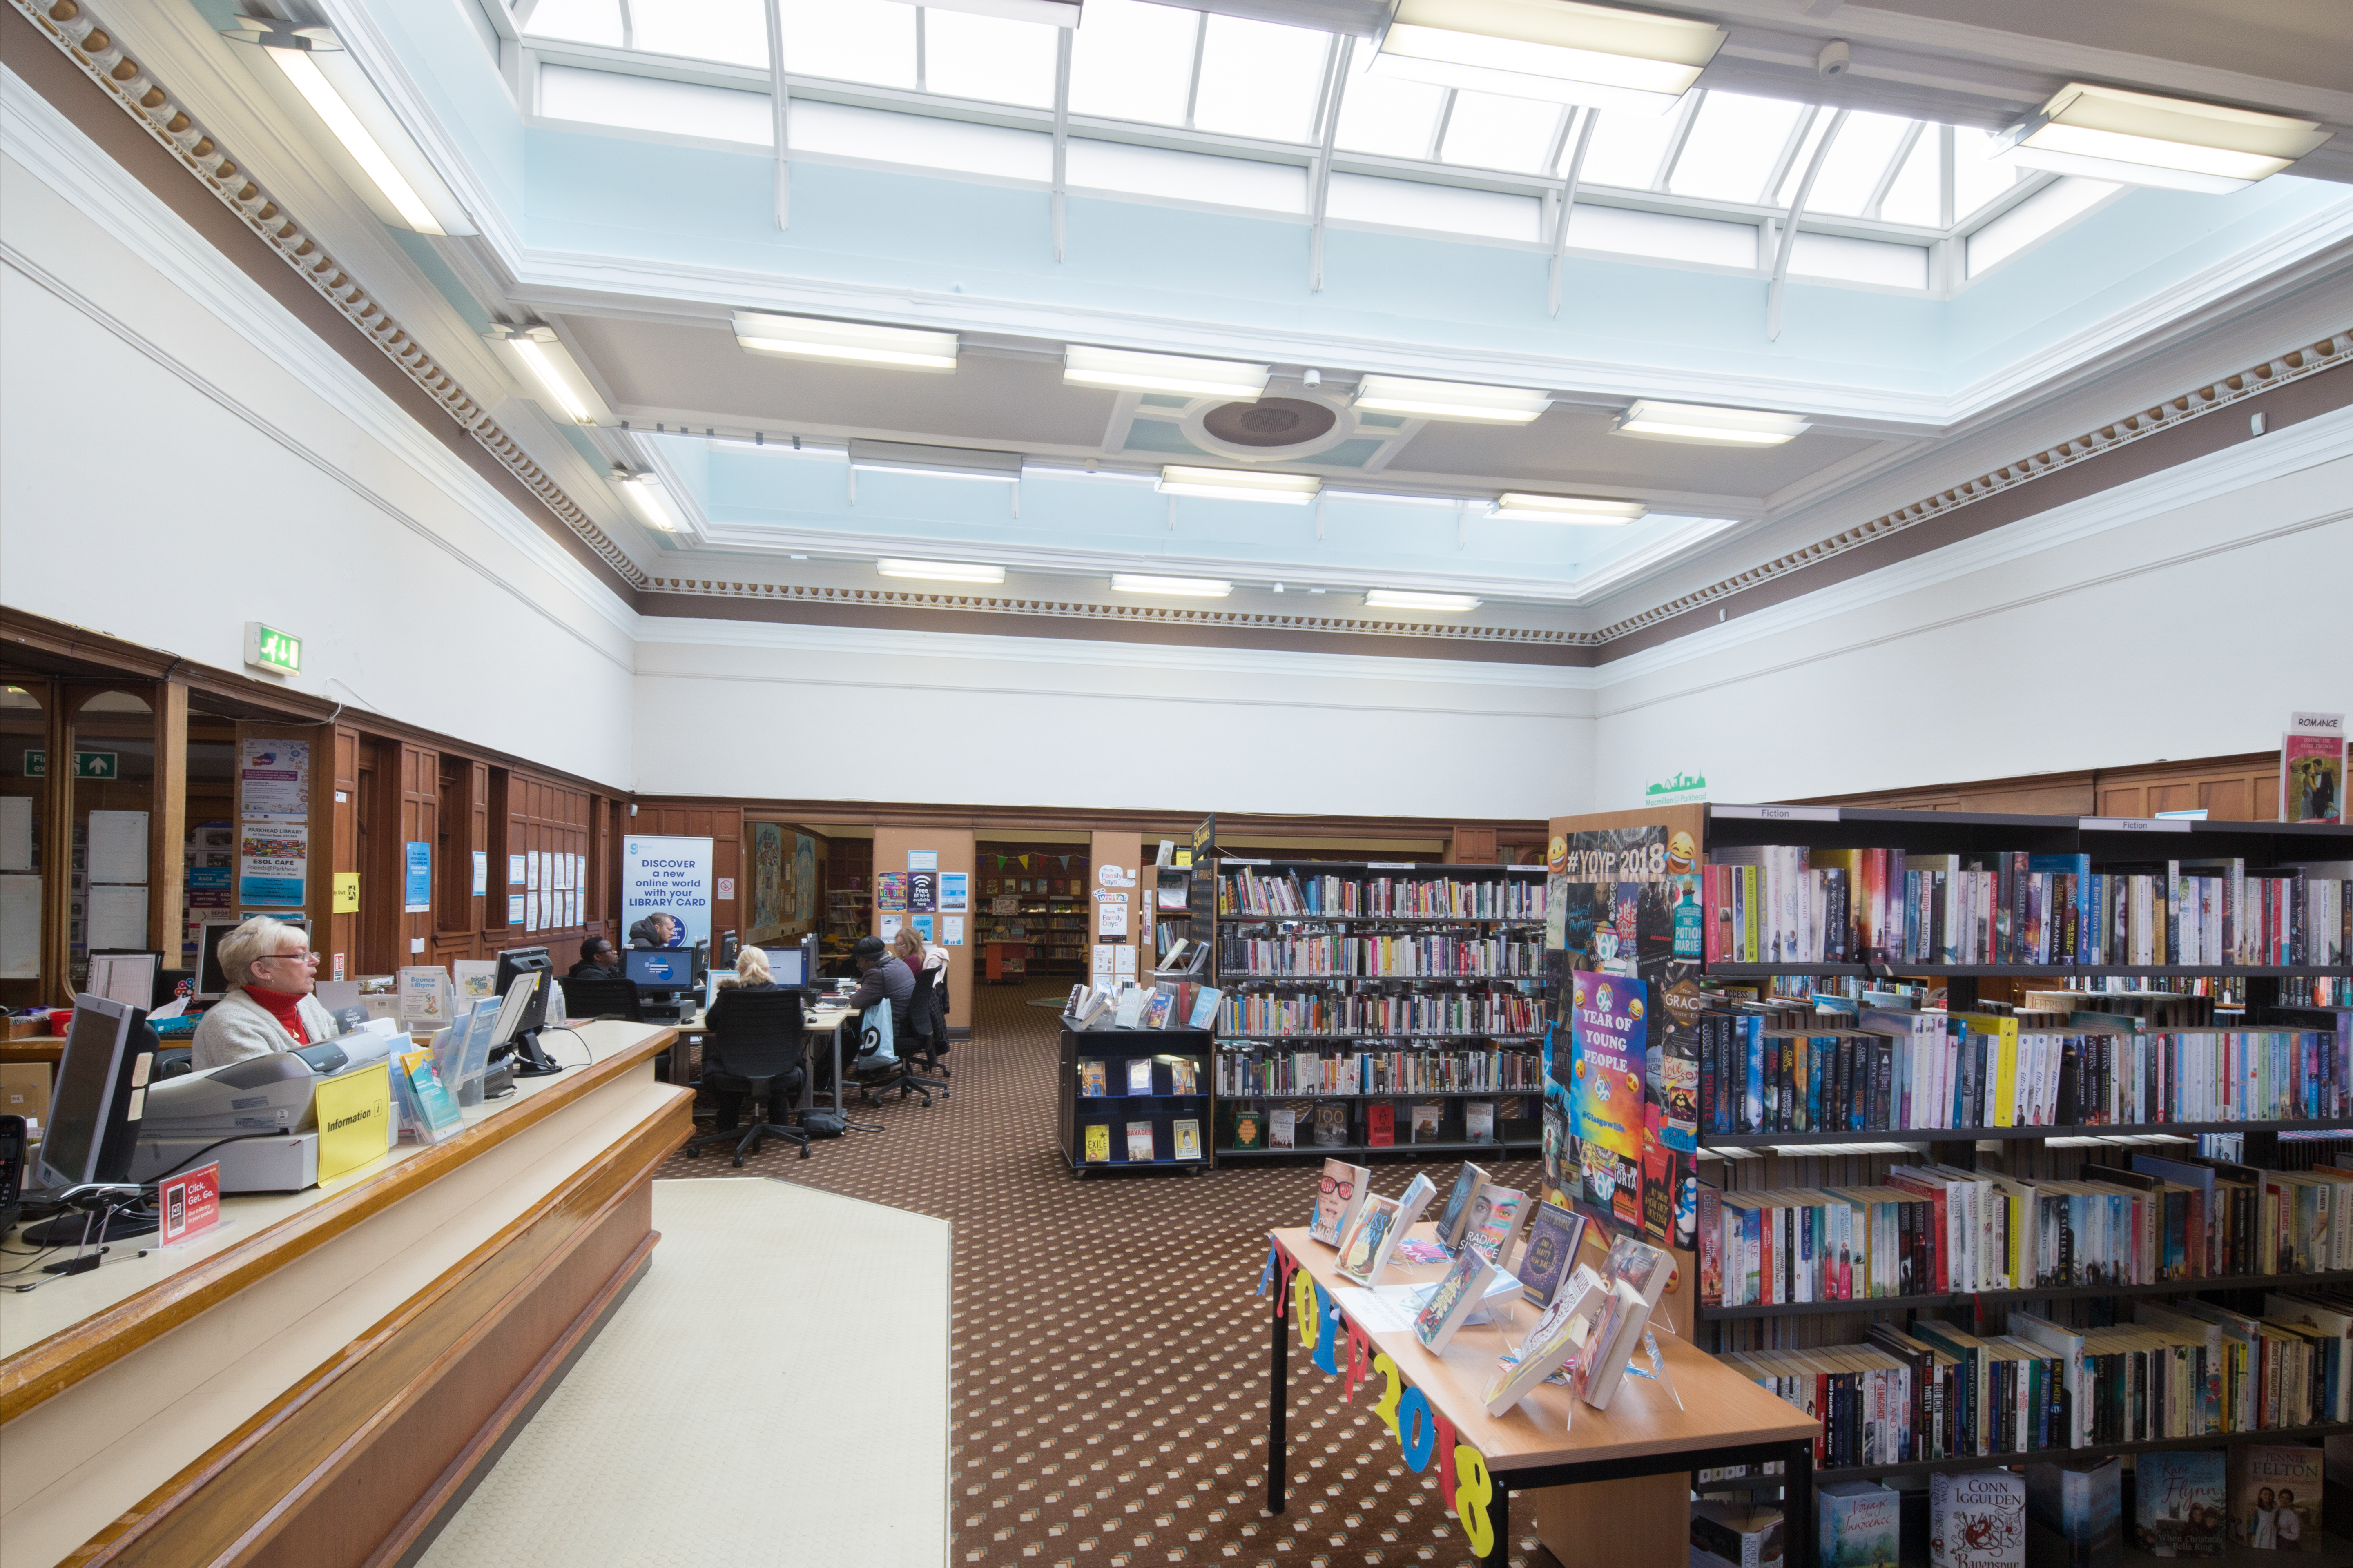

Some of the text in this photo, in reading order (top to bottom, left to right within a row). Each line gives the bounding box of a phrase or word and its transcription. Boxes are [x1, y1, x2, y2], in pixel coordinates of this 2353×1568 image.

[2298, 718, 2338, 728] ROMANCE
[1761, 808, 1789, 818] Fiction
[2123, 821, 2148, 829] Fiction
[1197, 827, 1210, 847] BOOKS
[642, 859, 696, 868] DISCOVER
[1567, 842, 1665, 873] #YOYP 2018
[1198, 869, 1212, 880] ARRIVALS
[644, 889, 692, 898] with your
[1093, 888, 1105, 897] wee
[1683, 917, 1693, 926] THE
[1724, 989, 1748, 998] ACCESS
[1582, 1009, 1633, 1032] YEAR OF
[1585, 1029, 1628, 1052] YOUNG
[1584, 1049, 1628, 1073] PEOPLE
[1704, 1074, 1714, 1120] PIRATE
[327, 1108, 371, 1133] Information
[1316, 1109, 1344, 1123] 100
[1582, 1111, 1626, 1133] @Glasgowlife
[1088, 1139, 1107, 1149] EXILE
[188, 1182, 205, 1194] Click.
[1320, 1176, 1354, 1199] GEEK GIRL
[188, 1190, 214, 1205] Get. Go.
[192, 1215, 201, 1223] your
[201, 1208, 214, 1218] pocket!
[195, 1204, 211, 1213] e-library
[1614, 1209, 1637, 1225] HELEN DENNIS
[1704, 1194, 1713, 1235] DEMILLE
[1318, 1214, 1338, 1229] HOLLY
[1362, 1209, 1388, 1232] KISS
[1539, 1209, 1572, 1231] HOLLY BOURNE
[1310, 1222, 1339, 1243] SMALE
[1356, 1226, 1381, 1248] CAM
[1466, 1231, 1499, 1247] RADIO
[1536, 1248, 1551, 1259] HAPPY
[1924, 1367, 1933, 1385] RED
[1877, 1384, 1885, 1420] SLINGSHOT
[1924, 1385, 1932, 1412] MOTH
[1934, 1383, 1943, 1413] RED ICON
[2266, 1452, 2306, 1464] JENNIE
[2162, 1459, 2190, 1476] Katie
[2252, 1461, 2319, 1478] FELTON
[1968, 1479, 2009, 1493] CONN
[2161, 1476, 2219, 1512] Flynn
[1954, 1487, 2022, 1509] IGGULDEN
[1851, 1498, 1888, 1516] Voyage
[1842, 1516, 1890, 1534] Innocence
[2158, 1533, 2223, 1544] When Christmas
[2172, 1542, 2213, 1552] Bells Ring
